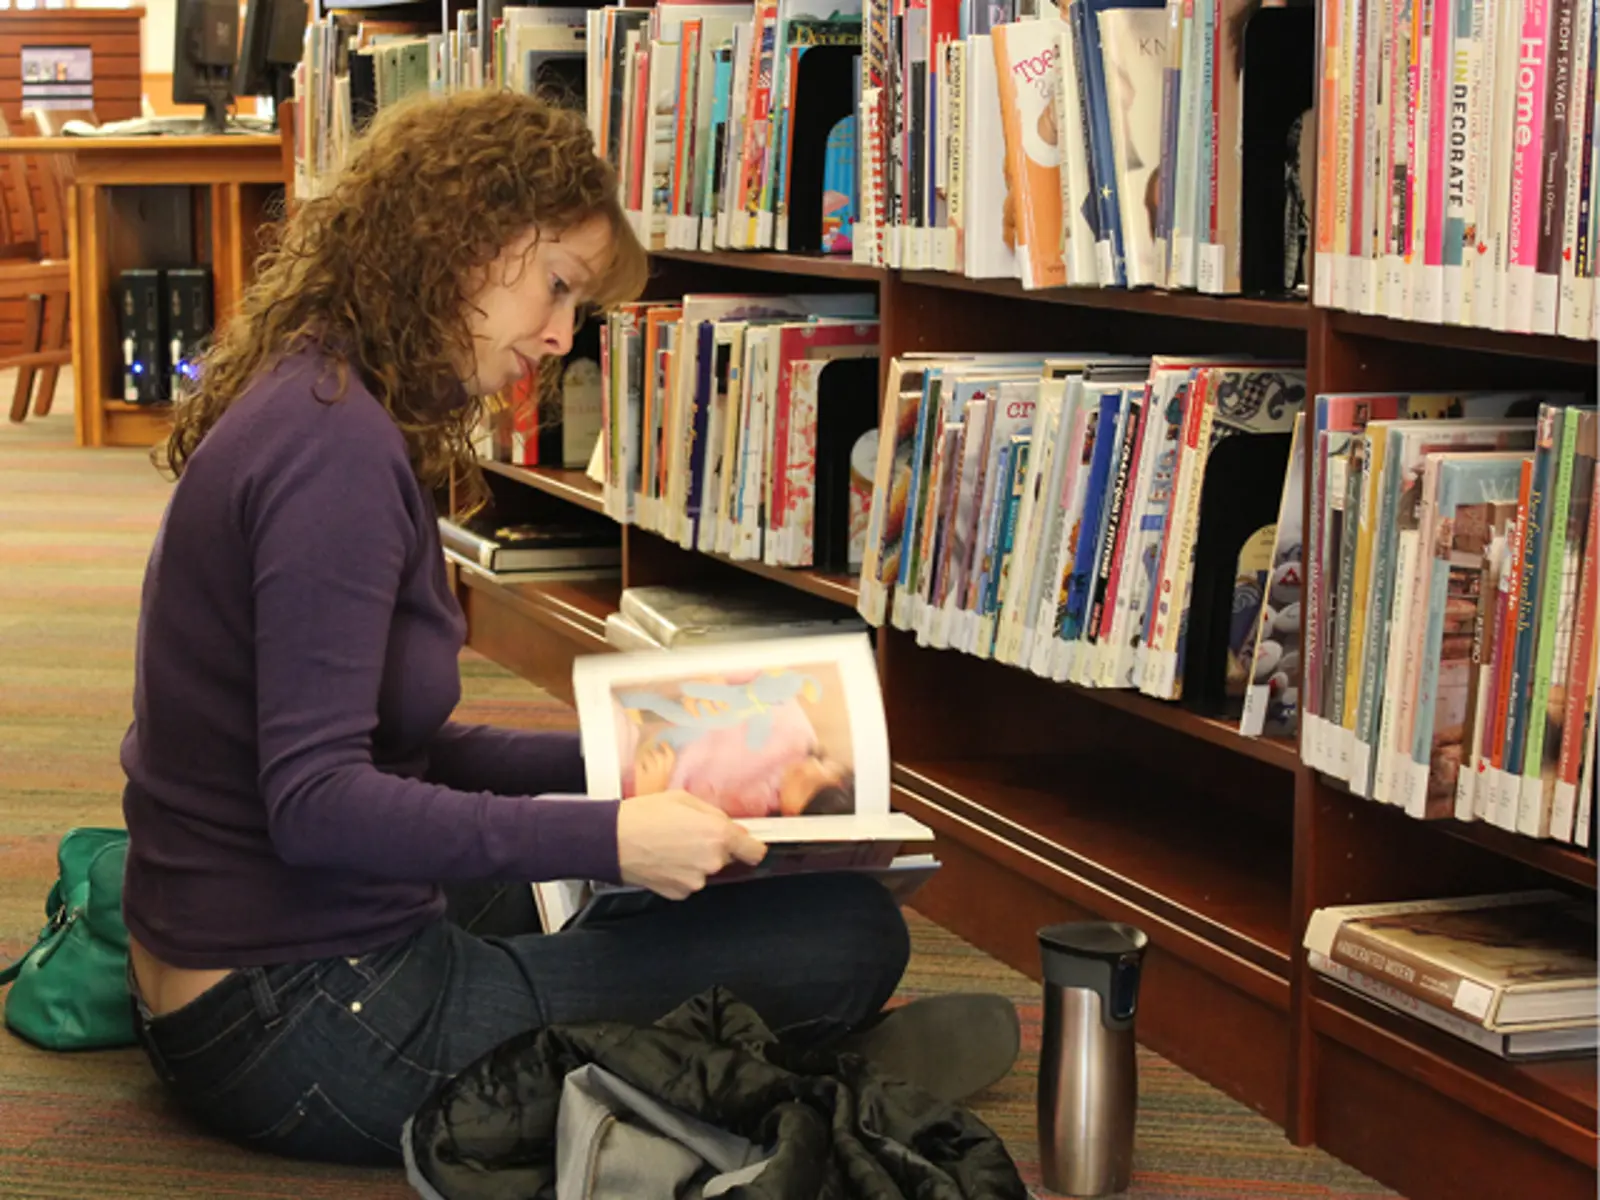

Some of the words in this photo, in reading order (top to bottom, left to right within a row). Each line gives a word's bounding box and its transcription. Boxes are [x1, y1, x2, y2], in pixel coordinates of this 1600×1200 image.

[1558, 9, 1571, 50] FROM
[1472, 80, 1481, 109] New
[1516, 38, 1543, 146] Home
[1554, 57, 1568, 120] SALVAGE
[1450, 51, 1468, 208] UNDECORATE
[1470, 112, 1480, 141] Look
[1337, 138, 1349, 223] RENOVATIONS
[1466, 154, 1479, 206] Country
[1546, 152, 1557, 183] Thomas
[1510, 505, 1526, 566] vintage
[1525, 491, 1541, 556] Perfect
[1507, 569, 1518, 611] style
[1518, 563, 1534, 632] English
